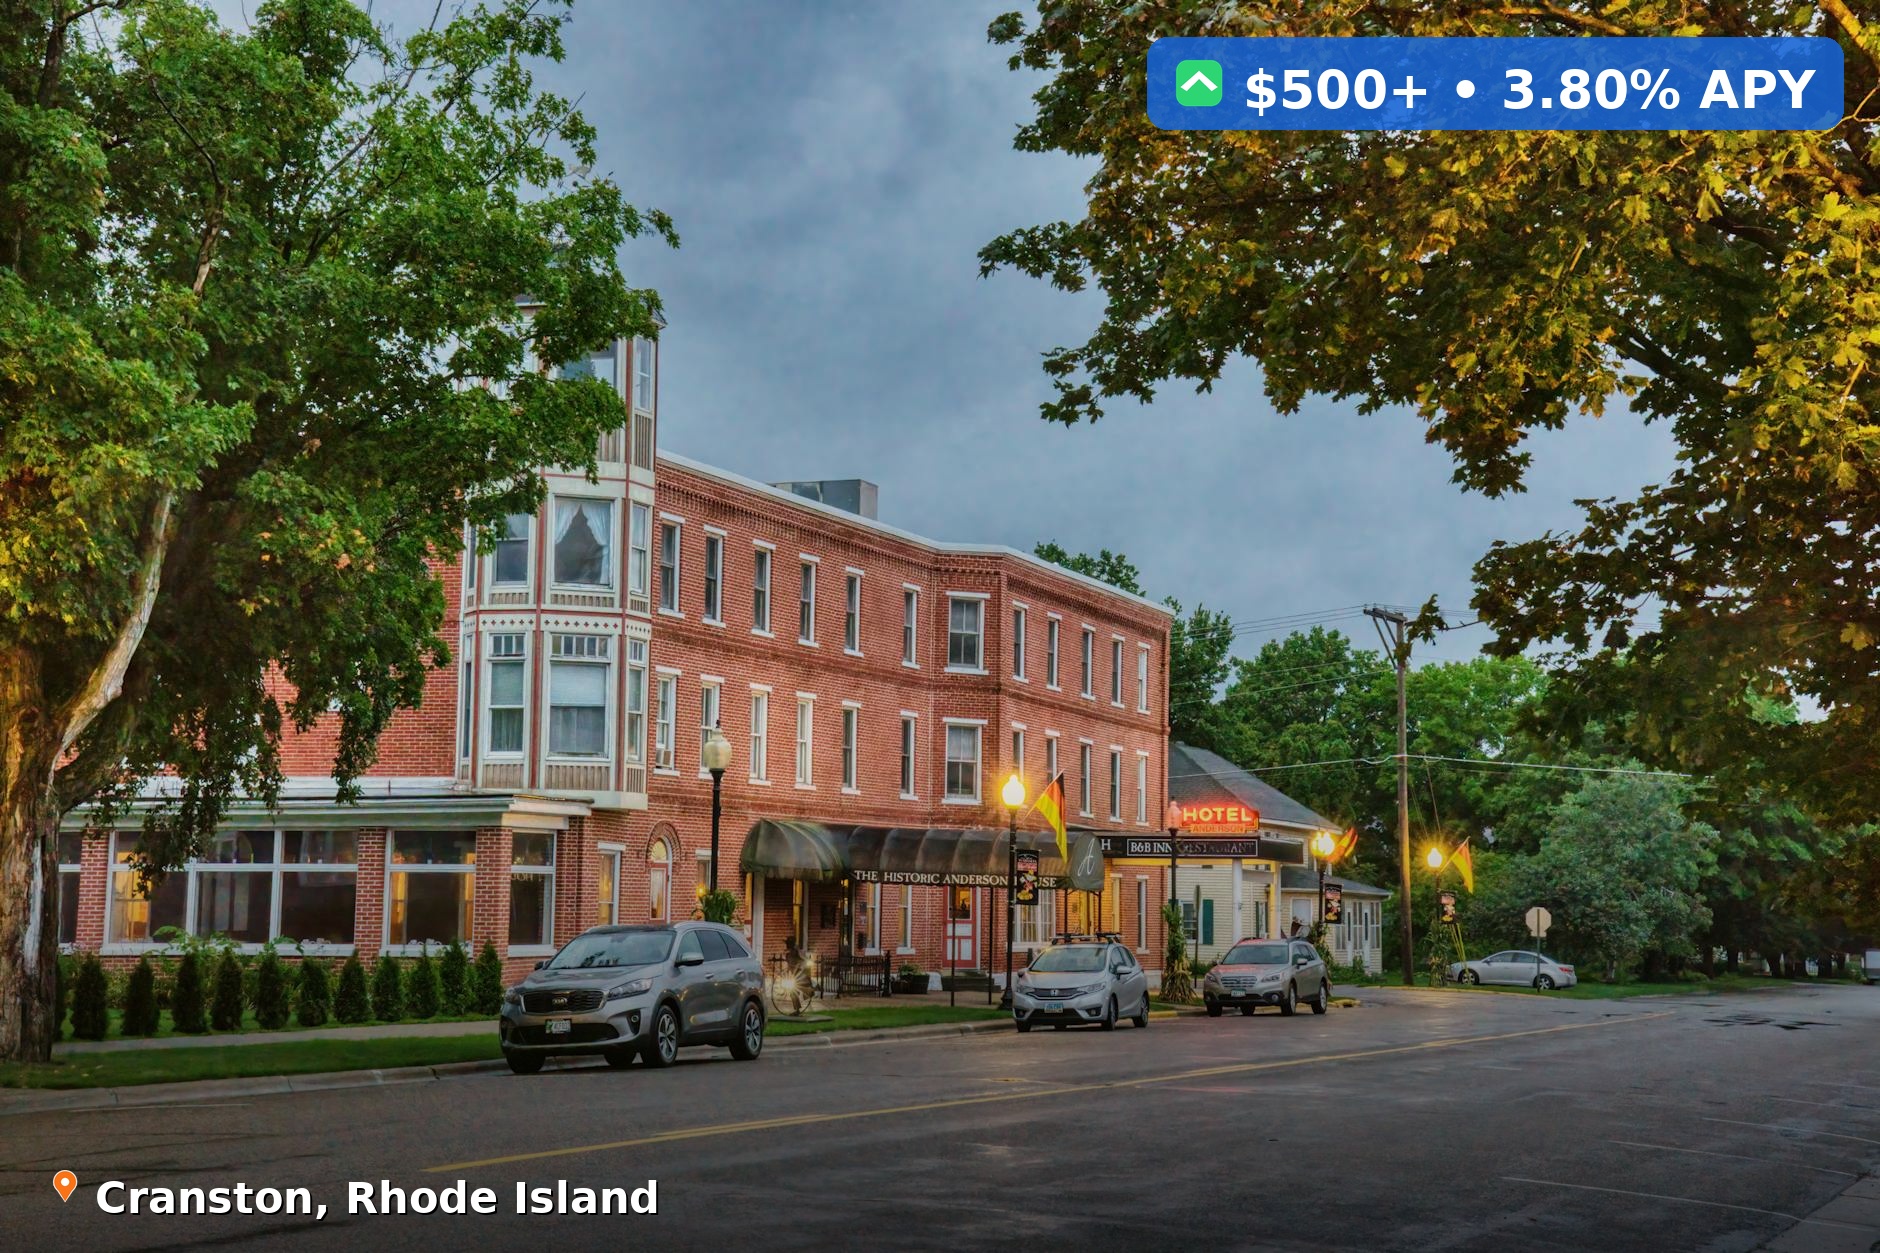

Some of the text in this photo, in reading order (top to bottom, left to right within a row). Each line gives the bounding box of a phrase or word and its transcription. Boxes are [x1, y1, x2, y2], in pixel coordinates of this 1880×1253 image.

[1183, 807, 1252, 822] HOTEL
[1192, 825, 1244, 833] ANDERSON
[1130, 841, 1151, 853] B&B
[1153, 841, 1173, 853] INN
[854, 870, 878, 881] THE
[884, 872, 940, 884] HISTORIC
[943, 874, 1009, 886] ANDERSON
